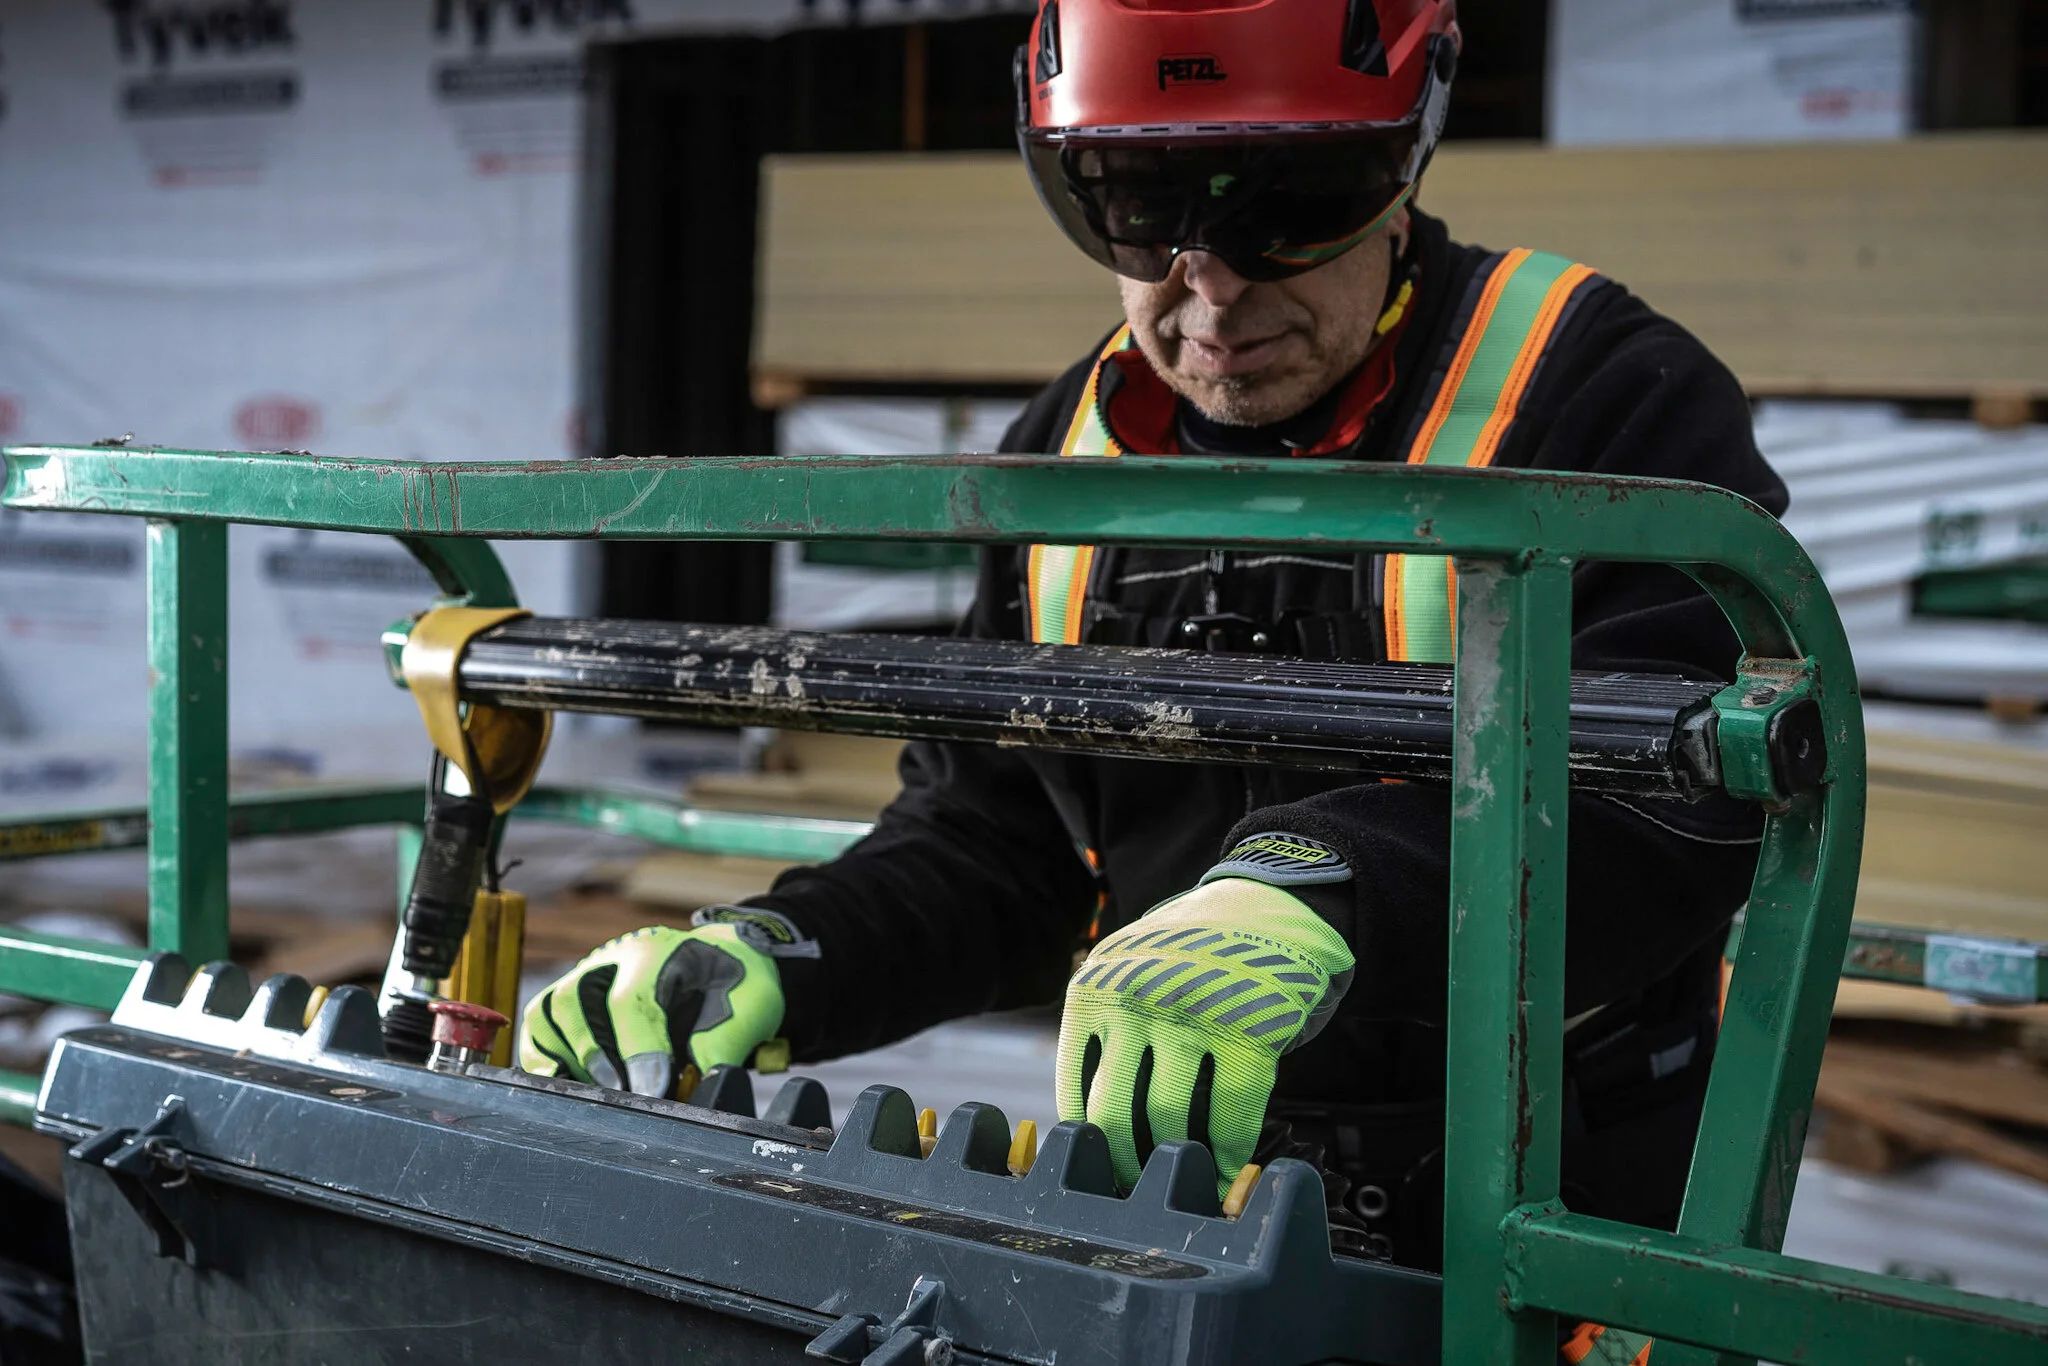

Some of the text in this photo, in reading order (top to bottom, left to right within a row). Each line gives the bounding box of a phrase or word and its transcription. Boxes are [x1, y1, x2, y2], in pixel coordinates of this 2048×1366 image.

[1158, 58, 1227, 91] PETZL
[1271, 843, 1323, 859] GRIP
[1233, 931, 1322, 975] SAFETY PRO
